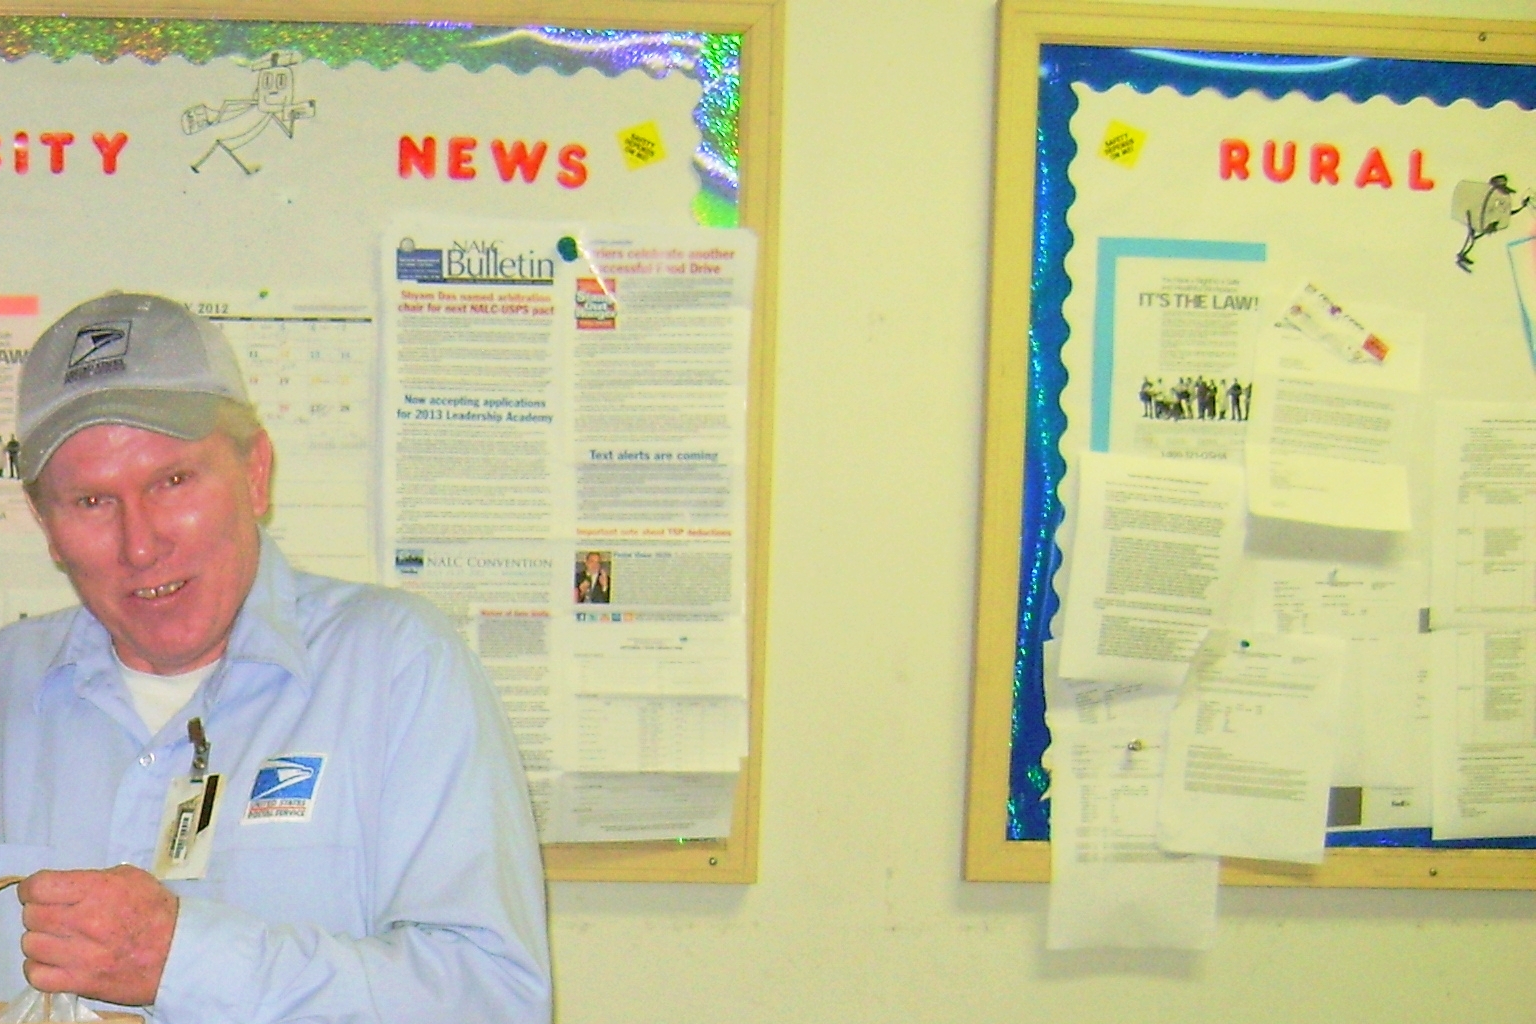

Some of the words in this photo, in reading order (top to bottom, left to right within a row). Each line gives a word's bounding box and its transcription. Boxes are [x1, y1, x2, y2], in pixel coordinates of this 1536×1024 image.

[397, 135, 588, 189] NEWS
[1220, 138, 1435, 191] RURAL
[447, 248, 554, 278] Bulletin
[198, 303, 229, 313] 2012
[1138, 292, 1170, 307] IT'S
[1174, 293, 1209, 309] THE
[1213, 295, 1259, 311] LAW!
[404, 395, 426, 404] Now
[429, 396, 479, 407] accepting
[483, 397, 546, 409] applications
[396, 409, 411, 419] for
[415, 409, 442, 419] 2013
[446, 410, 502, 422] Leadership
[506, 412, 553, 423] Academy
[589, 450, 613, 461] Text
[617, 450, 650, 461] alerts
[654, 452, 672, 461] are
[677, 451, 718, 463] coming
